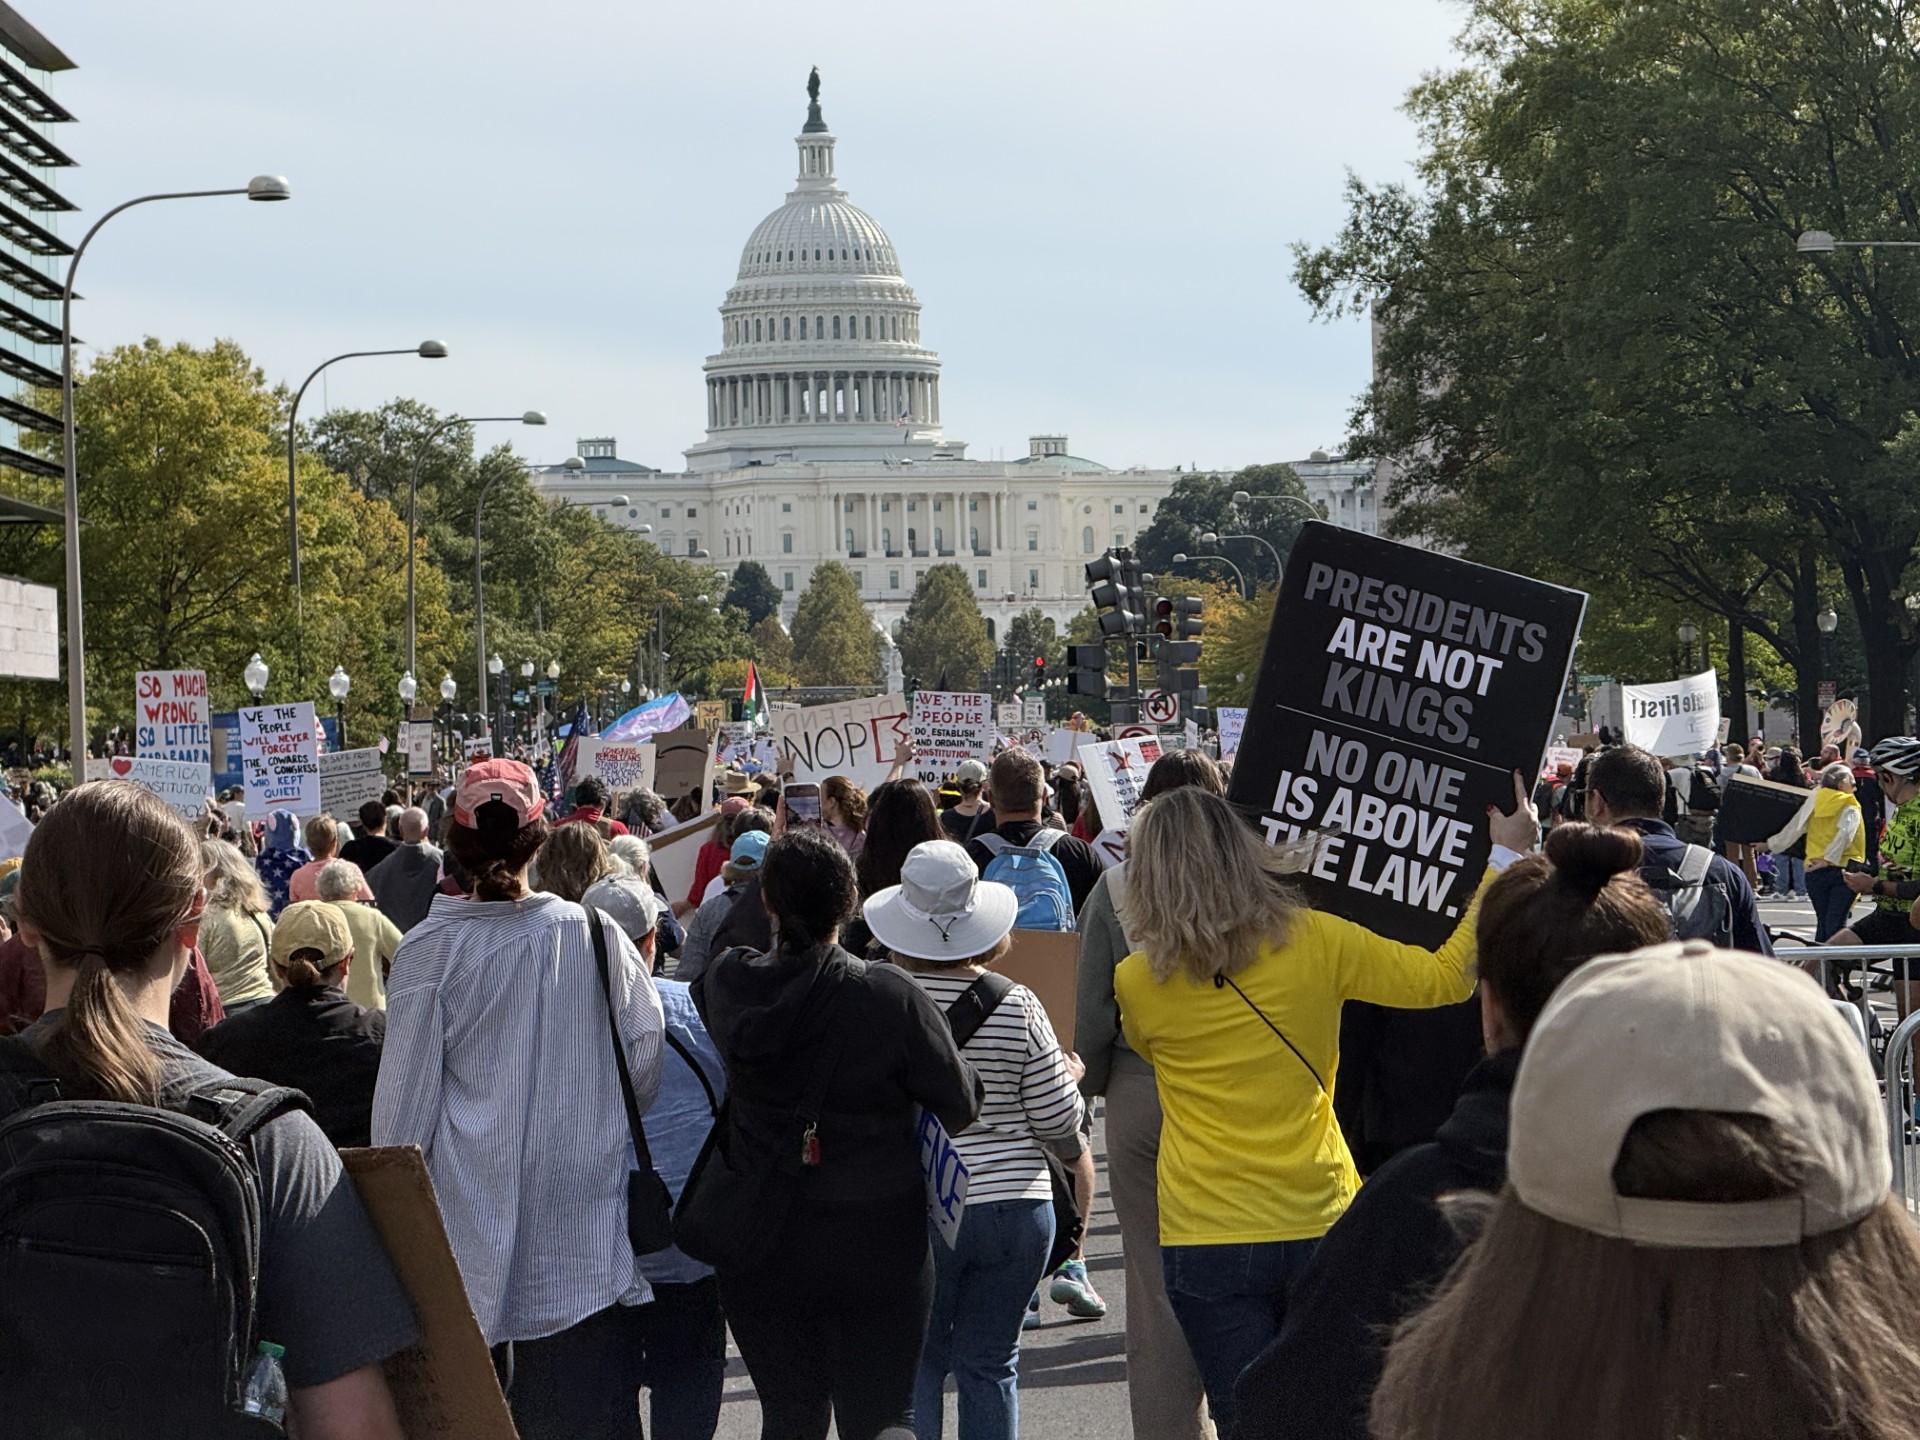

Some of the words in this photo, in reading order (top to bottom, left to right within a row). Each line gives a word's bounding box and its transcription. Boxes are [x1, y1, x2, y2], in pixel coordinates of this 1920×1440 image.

[1304, 562, 1547, 662] PRESIDENTS
[1326, 617, 1411, 673] ARE
[1414, 640, 1503, 696] NOT
[139, 676, 162, 698] SO
[173, 674, 206, 698] MUCH
[918, 692, 943, 706] WE
[951, 695, 982, 706] THE
[1321, 661, 1480, 749] KINGS.
[244, 711, 263, 722] WE
[274, 707, 296, 720] THE
[922, 711, 983, 724] PEOPLE
[258, 722, 291, 734] PEOPLE
[915, 727, 926, 736] DO
[931, 728, 975, 738] ESTABLISH
[138, 727, 155, 747] SO
[165, 724, 210, 746] LITTLE
[243, 736, 270, 746] WILL
[278, 732, 309, 743] NEVER
[262, 743, 298, 755] FORGET
[602, 746, 637, 755] CONGRESS
[916, 739, 932, 747] AND
[935, 739, 965, 748] ORDAIN
[968, 741, 984, 749] THE
[244, 758, 261, 769] THE
[268, 754, 309, 766] COWARDS
[595, 752, 642, 761] REPUBLICANS
[131, 761, 200, 780] AMERICA
[255, 769, 268, 777] IN
[274, 763, 318, 775] CONGRESS
[595, 760, 619, 770] STAND
[1304, 729, 1367, 784] NO
[1374, 752, 1466, 813] ONE
[600, 768, 644, 779] DEMOCRACY
[918, 771, 935, 783] NO
[1126, 776, 1144, 785] KGS
[250, 778, 270, 788] WHO
[278, 775, 304, 785] KEPT
[264, 787, 300, 798] QUIET!
[1272, 770, 1319, 820] IS
[1320, 787, 1473, 867] ABOVE
[1347, 845, 1457, 918] LAW.
[921, 1110, 969, 1223] ENCE
